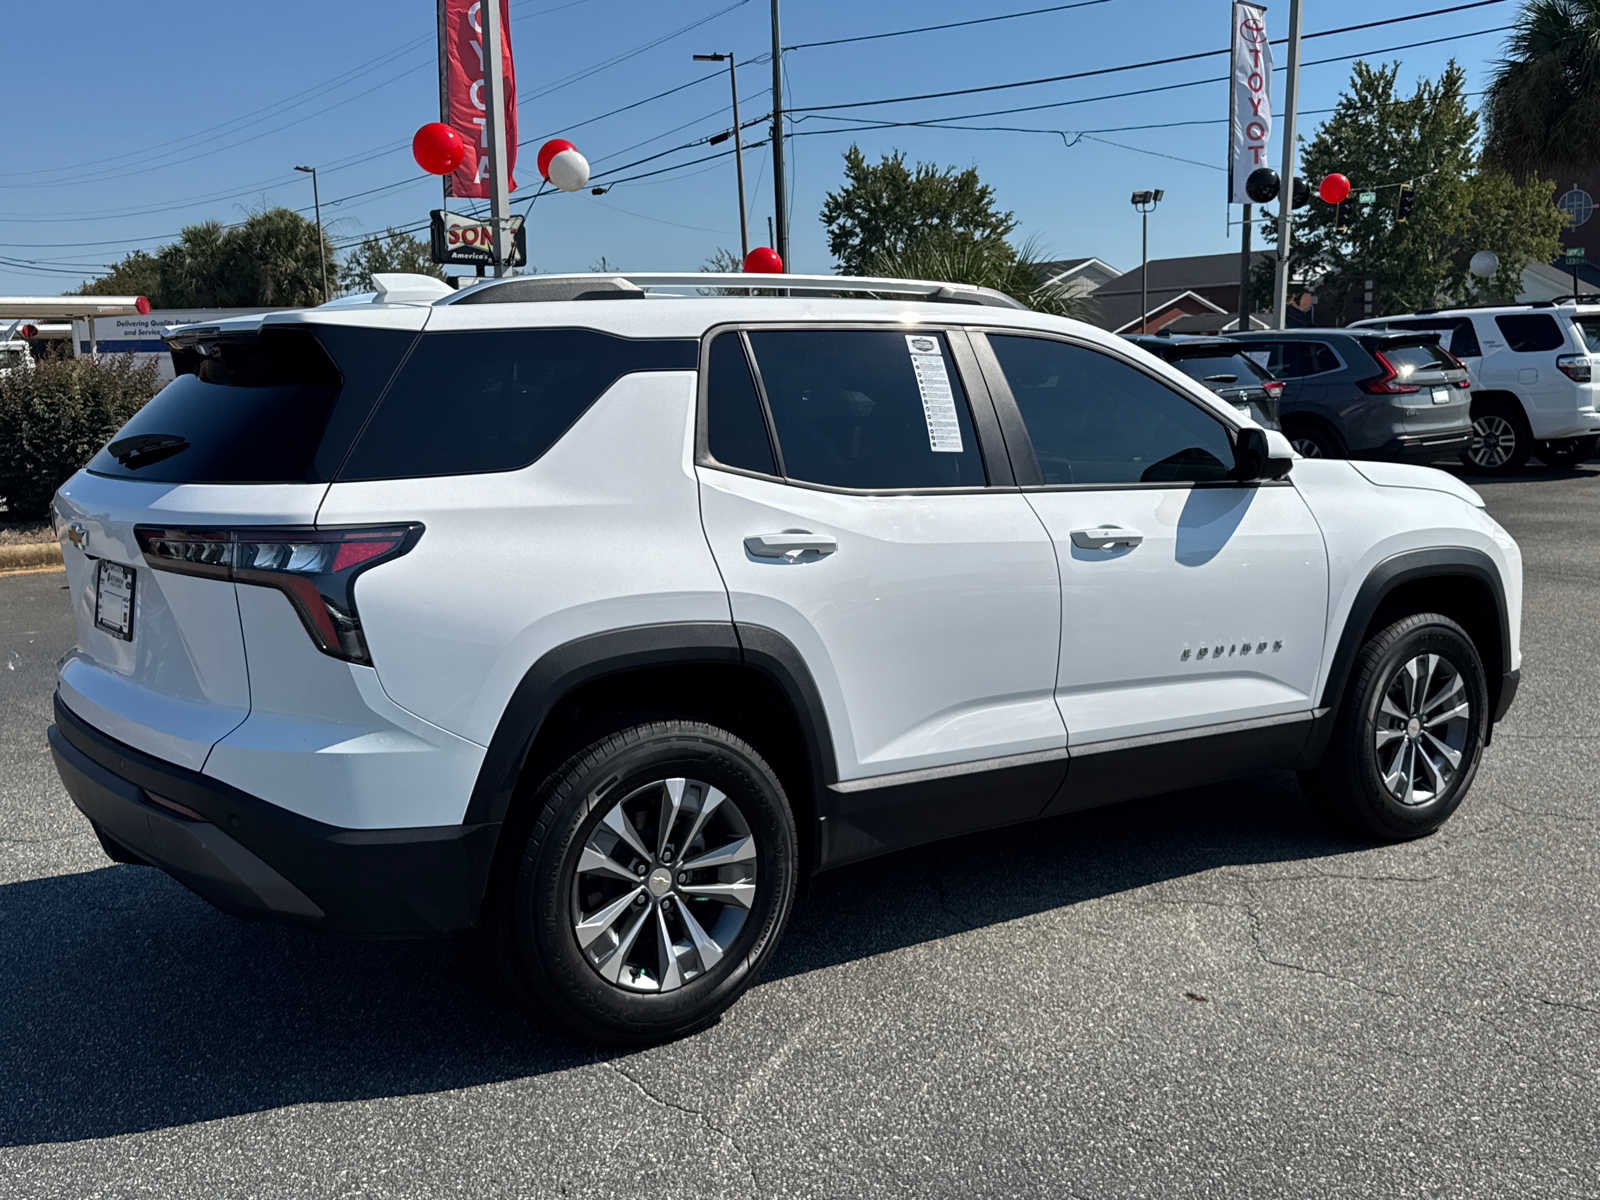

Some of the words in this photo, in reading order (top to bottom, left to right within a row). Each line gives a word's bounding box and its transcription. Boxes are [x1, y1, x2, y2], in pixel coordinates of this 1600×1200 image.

[451, 251, 488, 260] America's
[116, 320, 149, 328] Delivering
[150, 319, 174, 327] Quality
[124, 328, 136, 336] and
[1180, 640, 1283, 662] EQUINOX
